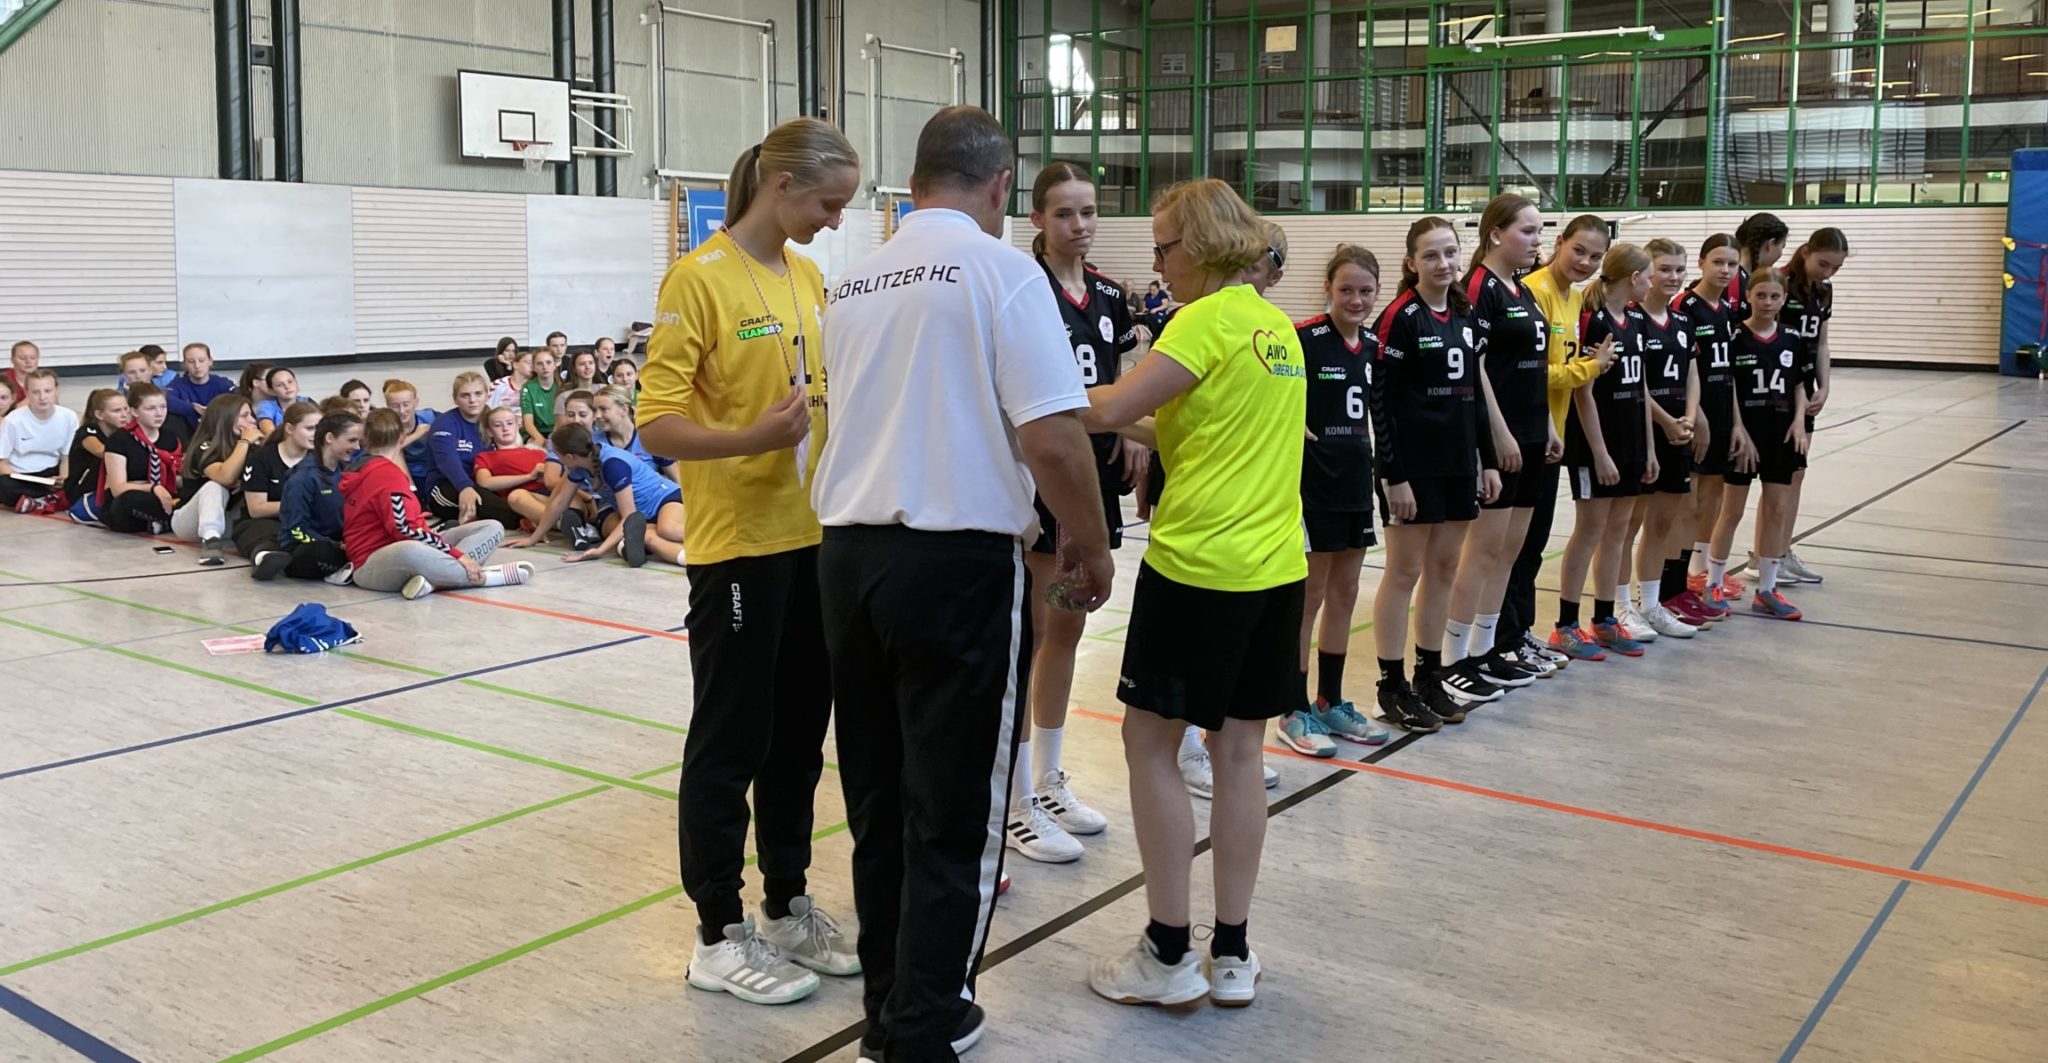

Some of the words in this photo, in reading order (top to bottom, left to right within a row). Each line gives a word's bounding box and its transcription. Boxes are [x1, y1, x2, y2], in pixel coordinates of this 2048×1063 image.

[929, 265, 960, 283] HC
[1096, 281, 1119, 299] skan
[1534, 320, 1546, 352] 5
[1800, 315, 1820, 338] 13
[1076, 344, 1097, 384] 8
[1266, 344, 1287, 360] AWO
[1384, 346, 1404, 359] skan
[1448, 347, 1464, 380] 9
[1711, 342, 1730, 368] 11
[1621, 355, 1641, 384] 10
[1663, 354, 1679, 381] 4
[1752, 368, 1785, 394] 14
[1346, 386, 1364, 419] 6
[731, 583, 742, 622] CRAFT
